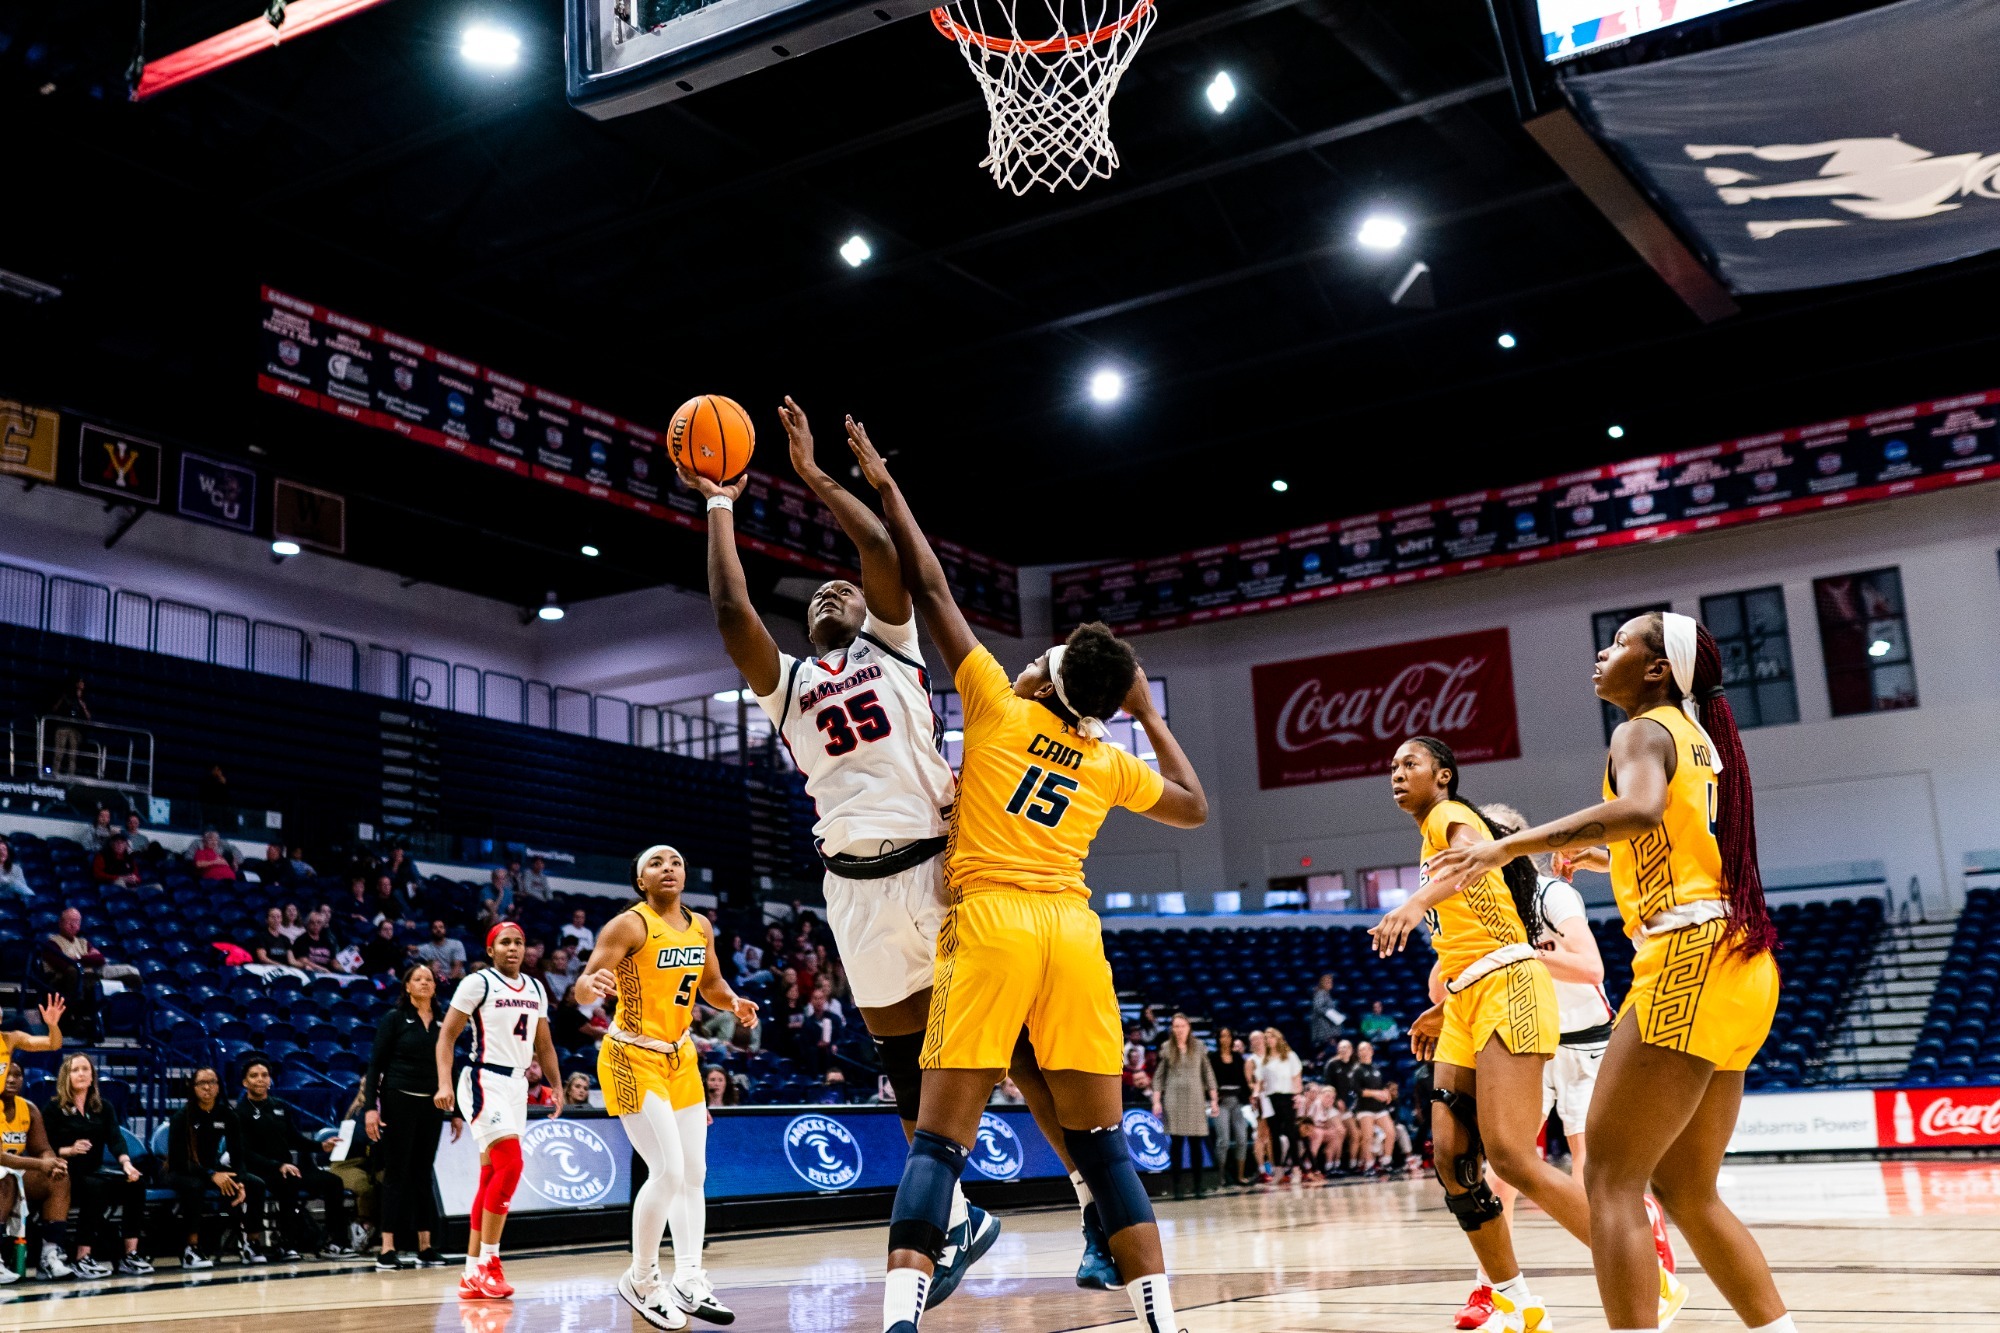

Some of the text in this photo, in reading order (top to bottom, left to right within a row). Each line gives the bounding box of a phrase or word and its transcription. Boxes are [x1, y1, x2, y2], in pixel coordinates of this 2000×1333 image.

[1276, 656, 1487, 752] Coca-Cola
[816, 689, 892, 757] 35
[1005, 765, 1079, 828] 15
[674, 973, 698, 1007] 5
[513, 1013, 528, 1041] 4
[573, 1128, 603, 1153] GAP
[1812, 1117, 1869, 1134] Power
[543, 1177, 604, 1200] EYE CARE
